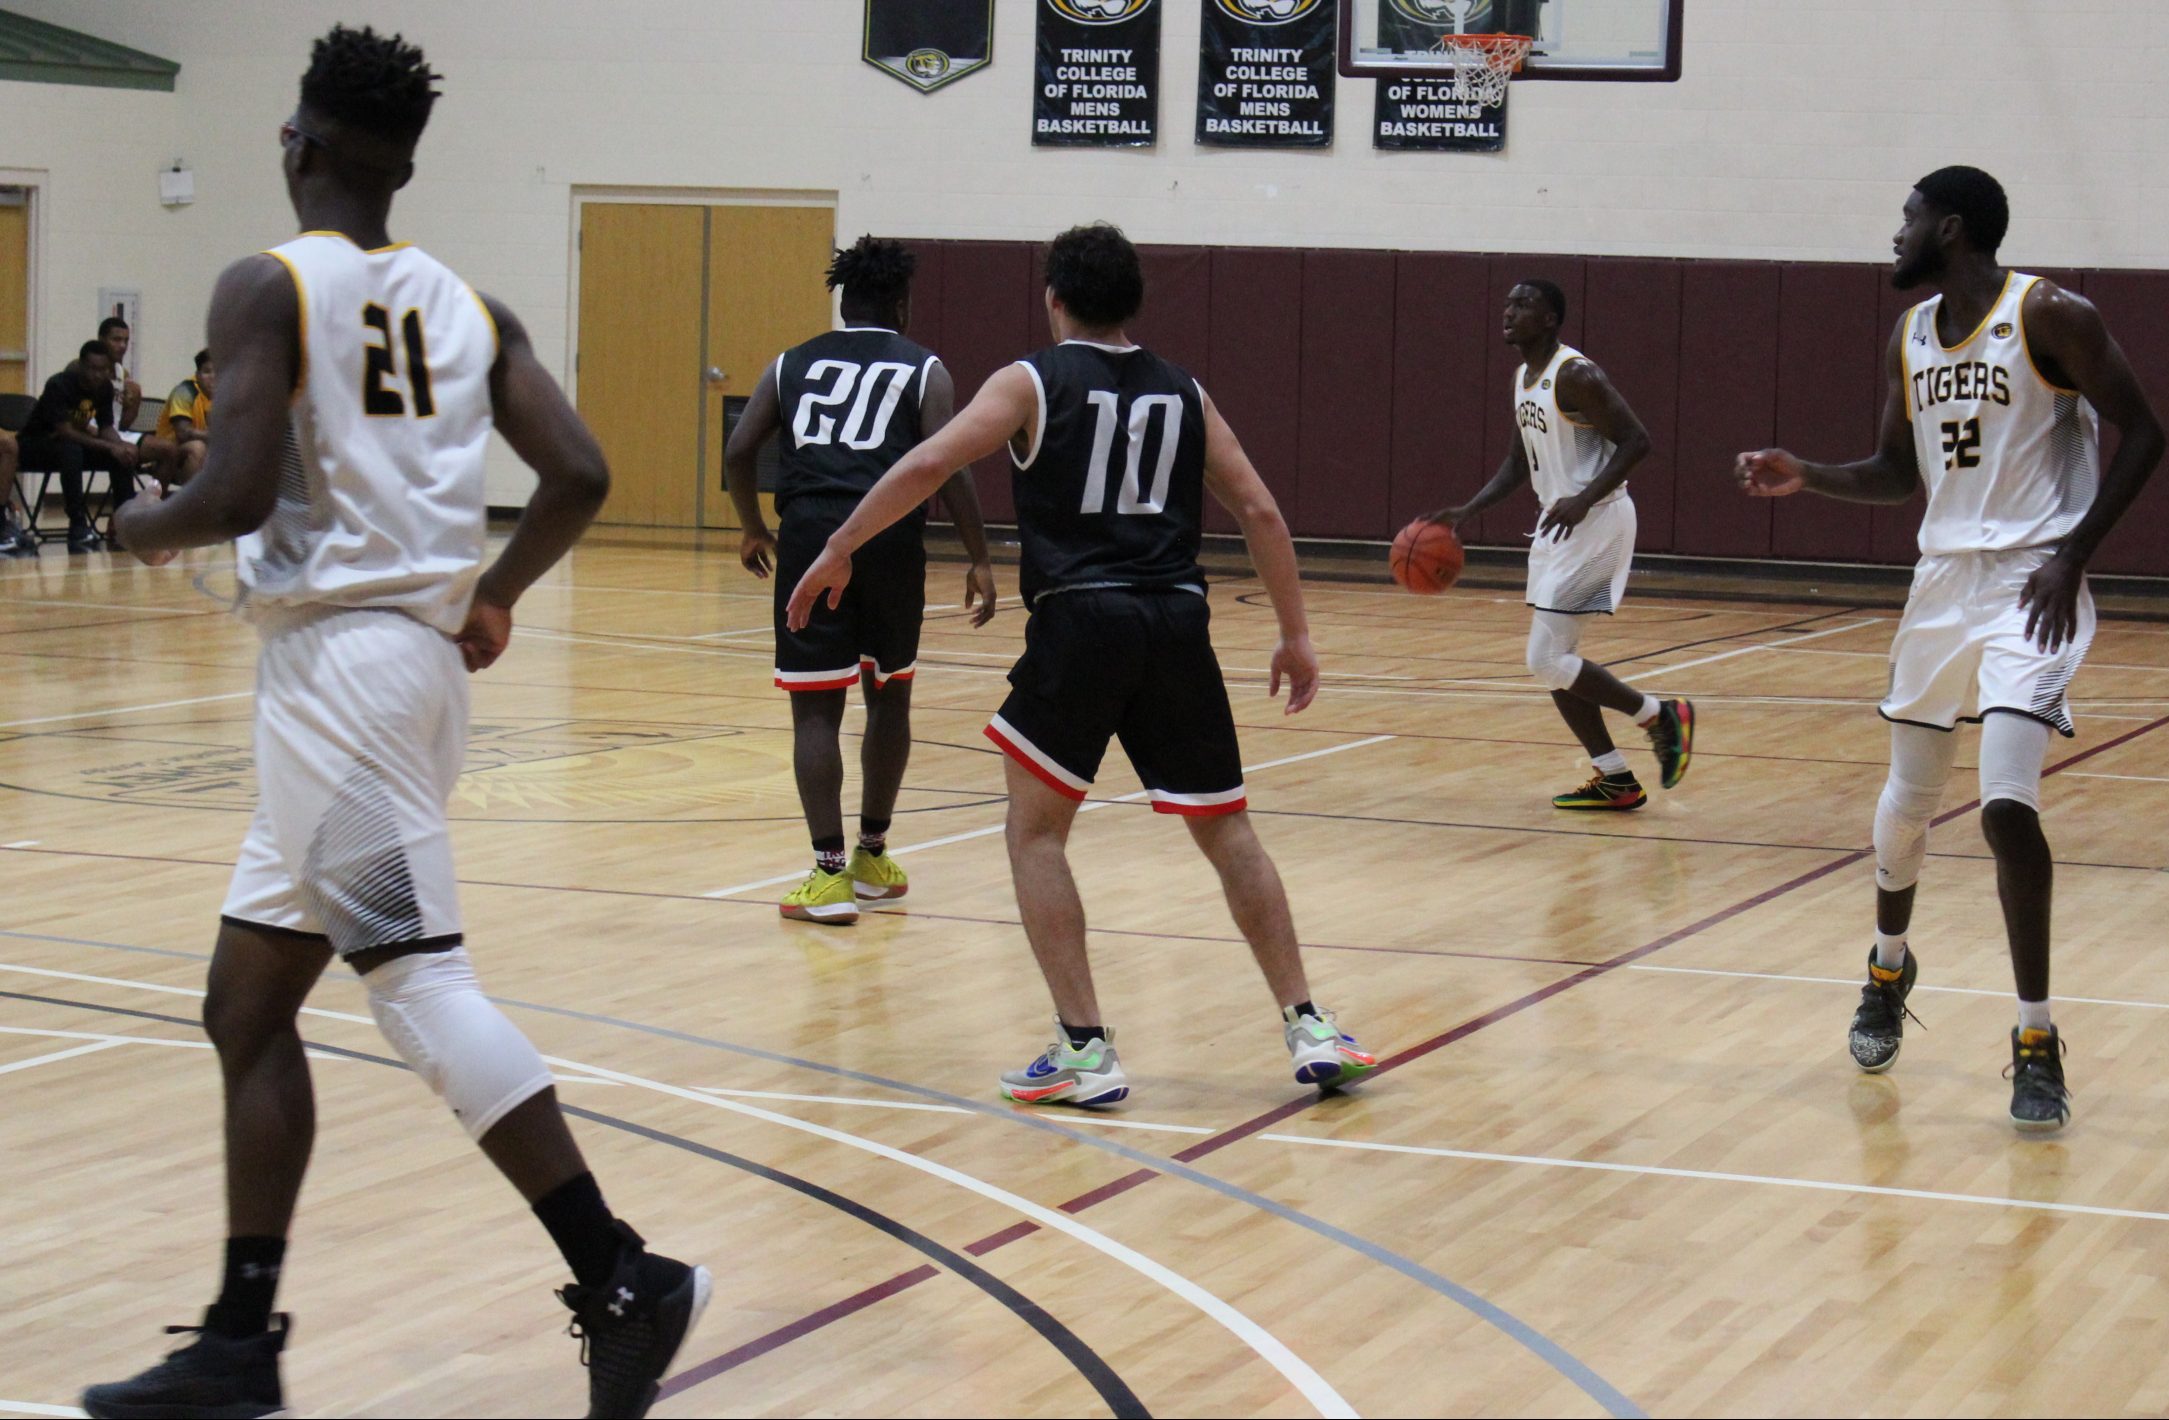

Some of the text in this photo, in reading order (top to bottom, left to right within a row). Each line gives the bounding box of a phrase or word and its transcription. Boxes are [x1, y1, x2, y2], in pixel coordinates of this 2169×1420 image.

[1061, 48, 1133, 64] TRINITY
[1230, 48, 1304, 64] TRINITY
[1056, 66, 1137, 82] COLLEGE
[1225, 65, 1308, 81] COLLEGE
[1044, 84, 1148, 100] OF FLORIDA
[1213, 83, 1320, 100] OF FLORIDA
[1387, 85, 1412, 100] OF
[1070, 102, 1121, 117] MENS
[1239, 102, 1291, 117] MENS
[1400, 104, 1482, 119] WOMENS
[1037, 118, 1151, 135] BASKETBALL
[1205, 118, 1324, 136] BASKETBALL
[1380, 121, 1500, 137] BASKETBALL
[362, 300, 436, 419] 21
[1912, 360, 2011, 412] TIGERS
[792, 359, 916, 450] 20
[1079, 390, 1184, 515] 10
